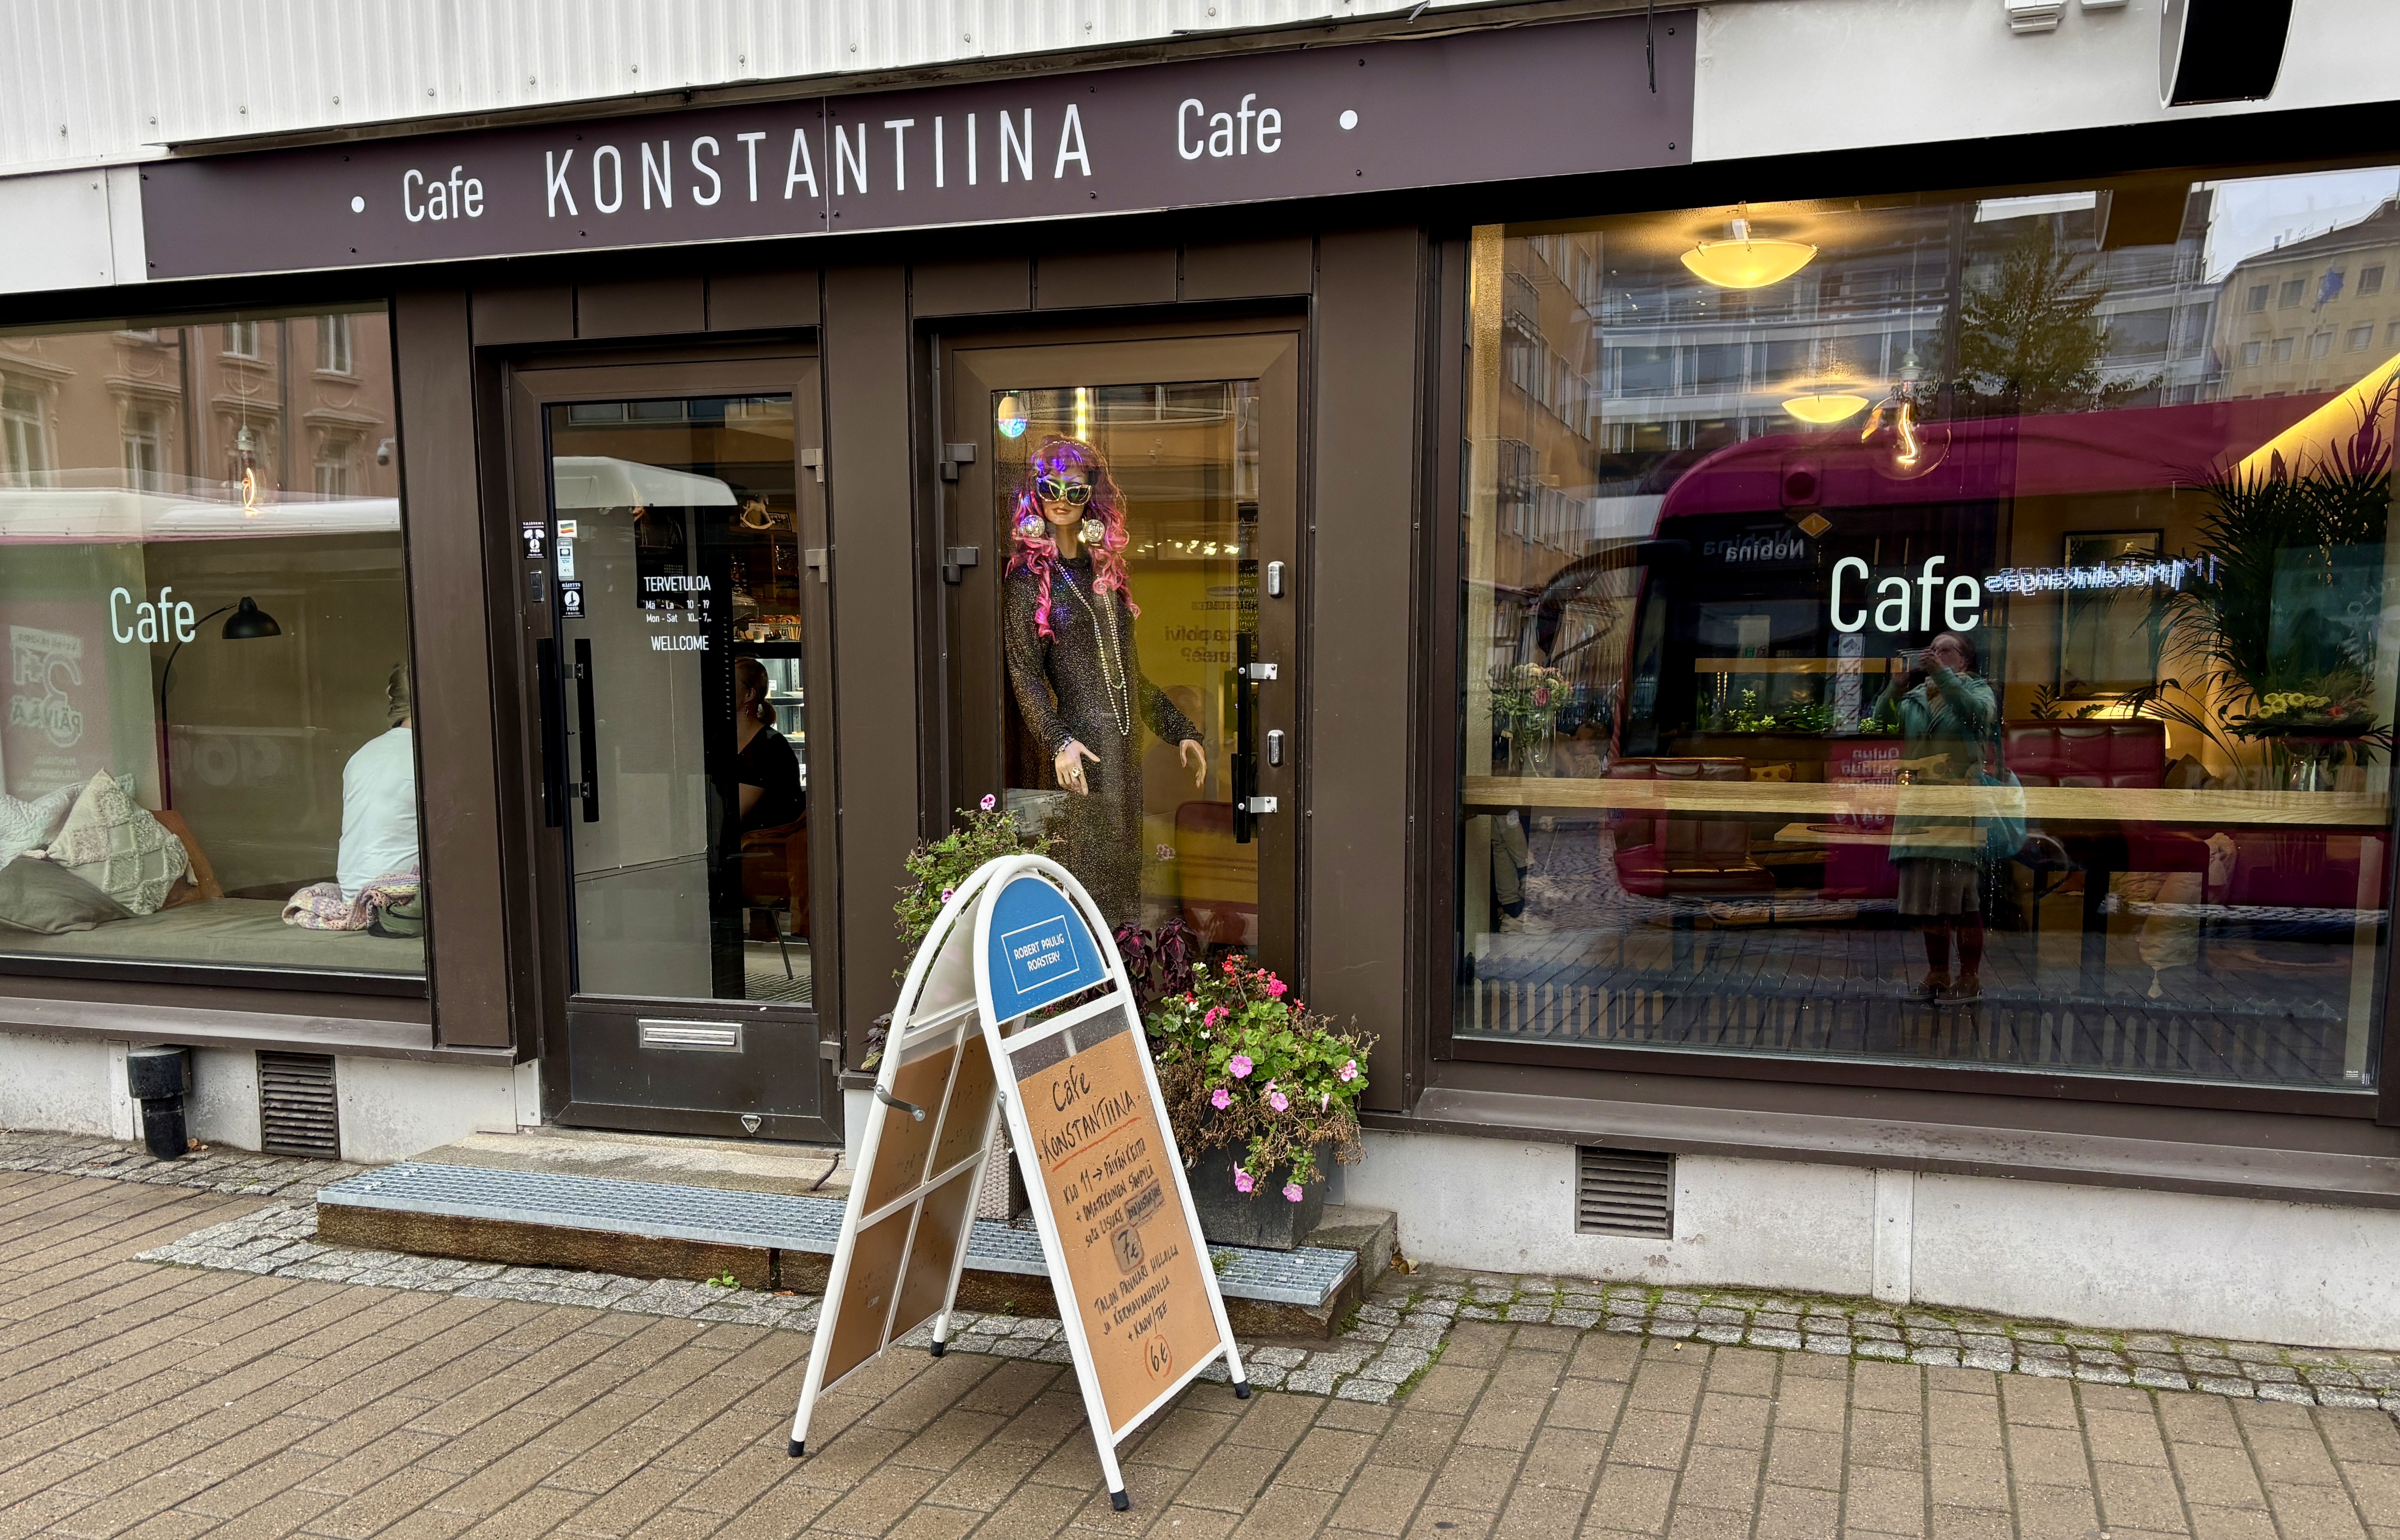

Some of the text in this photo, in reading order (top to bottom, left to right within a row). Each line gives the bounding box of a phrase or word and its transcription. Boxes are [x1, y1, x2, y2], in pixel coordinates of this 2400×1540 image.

[403, 93, 1282, 222] Cafe KONSTANTIINA Cafe
[644, 576, 711, 592] TERVETULOA
[1830, 555, 1980, 633] Cafe
[110, 586, 196, 644] Cafe
[646, 600, 656, 610] Ma
[666, 600, 674, 610] La
[687, 600, 694, 609] 10
[703, 600, 710, 609] 19
[646, 613, 660, 622] Mon
[666, 613, 678, 622] Sat
[651, 636, 709, 651] WELLCOME
[1013, 933, 1064, 960] ROBERT PAULIG
[1027, 950, 1060, 971] ROASTERY
[1053, 1065, 1090, 1111] Cafe
[1041, 1090, 1136, 1164] KONSTANTIINA
[1081, 1168, 1093, 1192] 11
[1095, 1288, 1119, 1315] TALON
